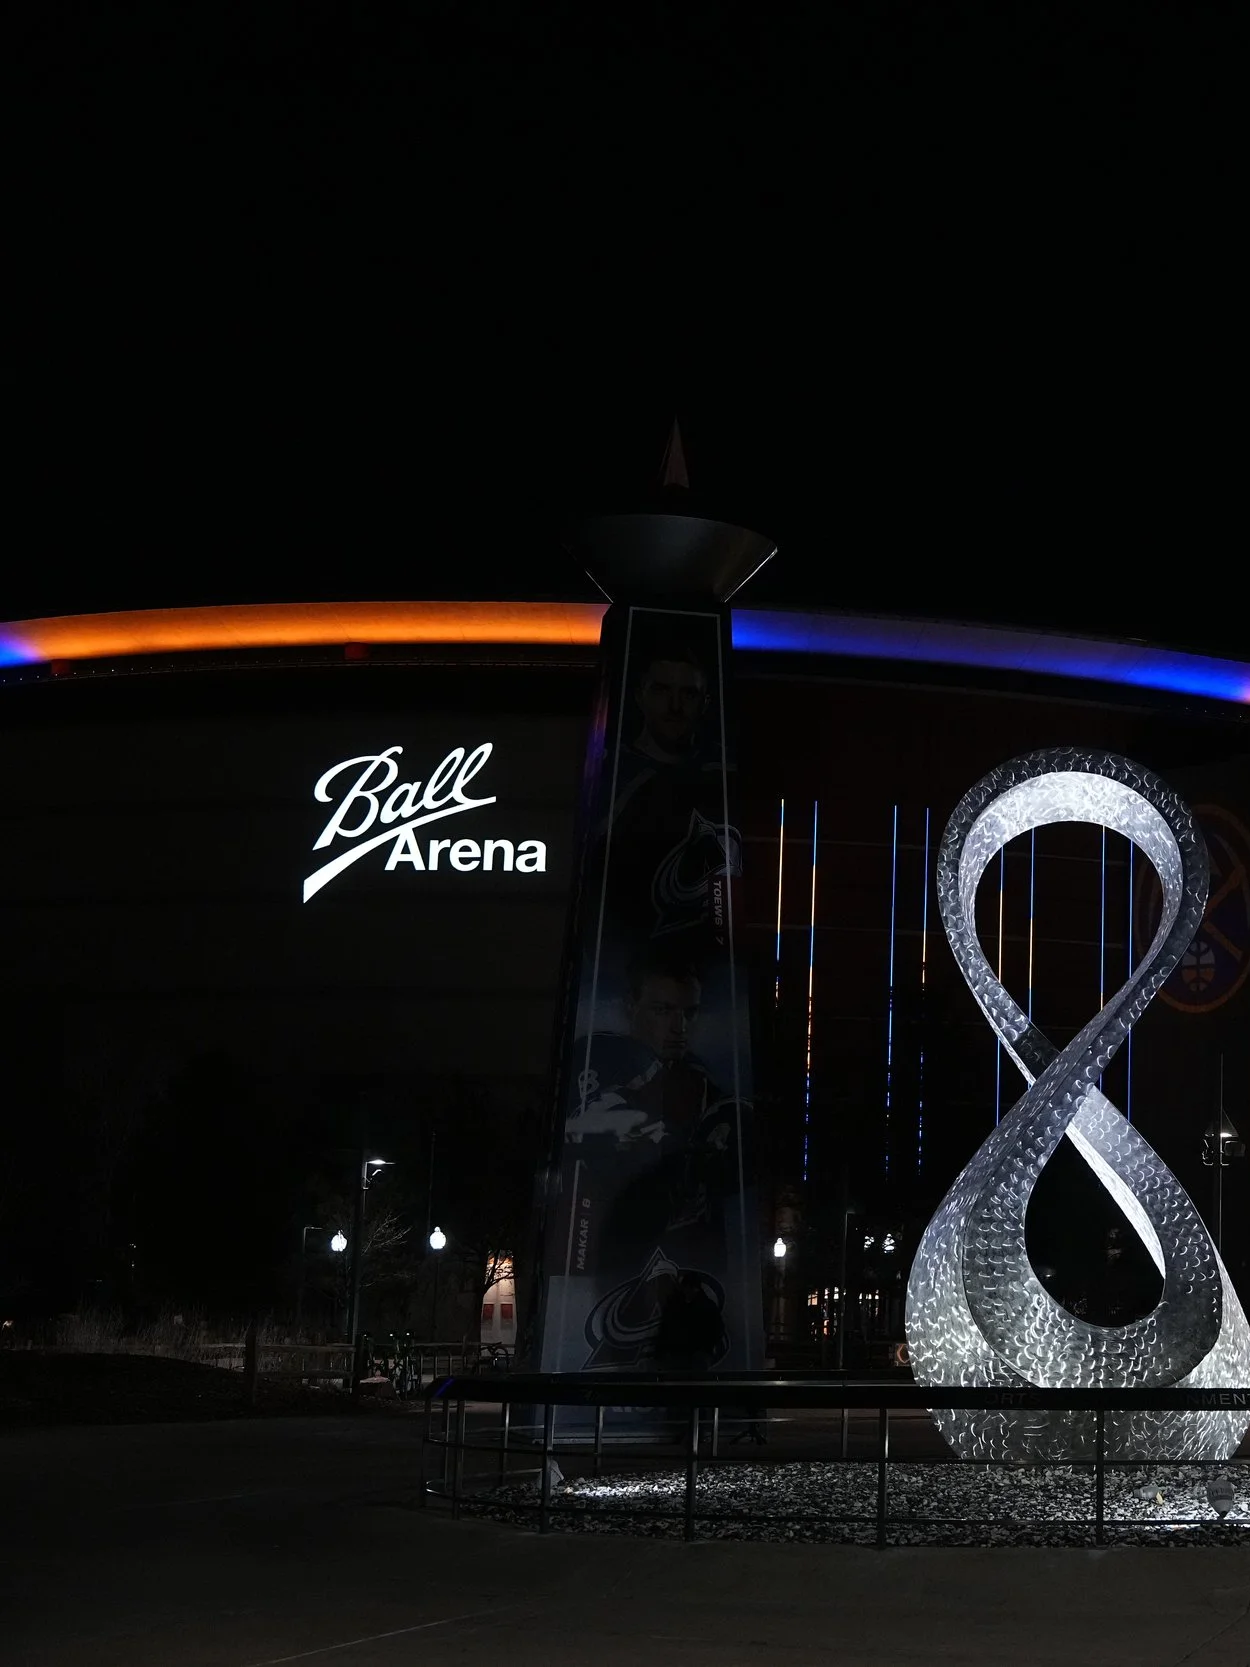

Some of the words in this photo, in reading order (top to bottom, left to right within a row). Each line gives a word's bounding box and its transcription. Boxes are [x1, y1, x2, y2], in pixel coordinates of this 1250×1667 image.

[303, 743, 497, 903] Ball
[384, 826, 547, 874] Arena
[713, 880, 724, 929] TOEWS
[576, 1218, 589, 1271] MAKAR
